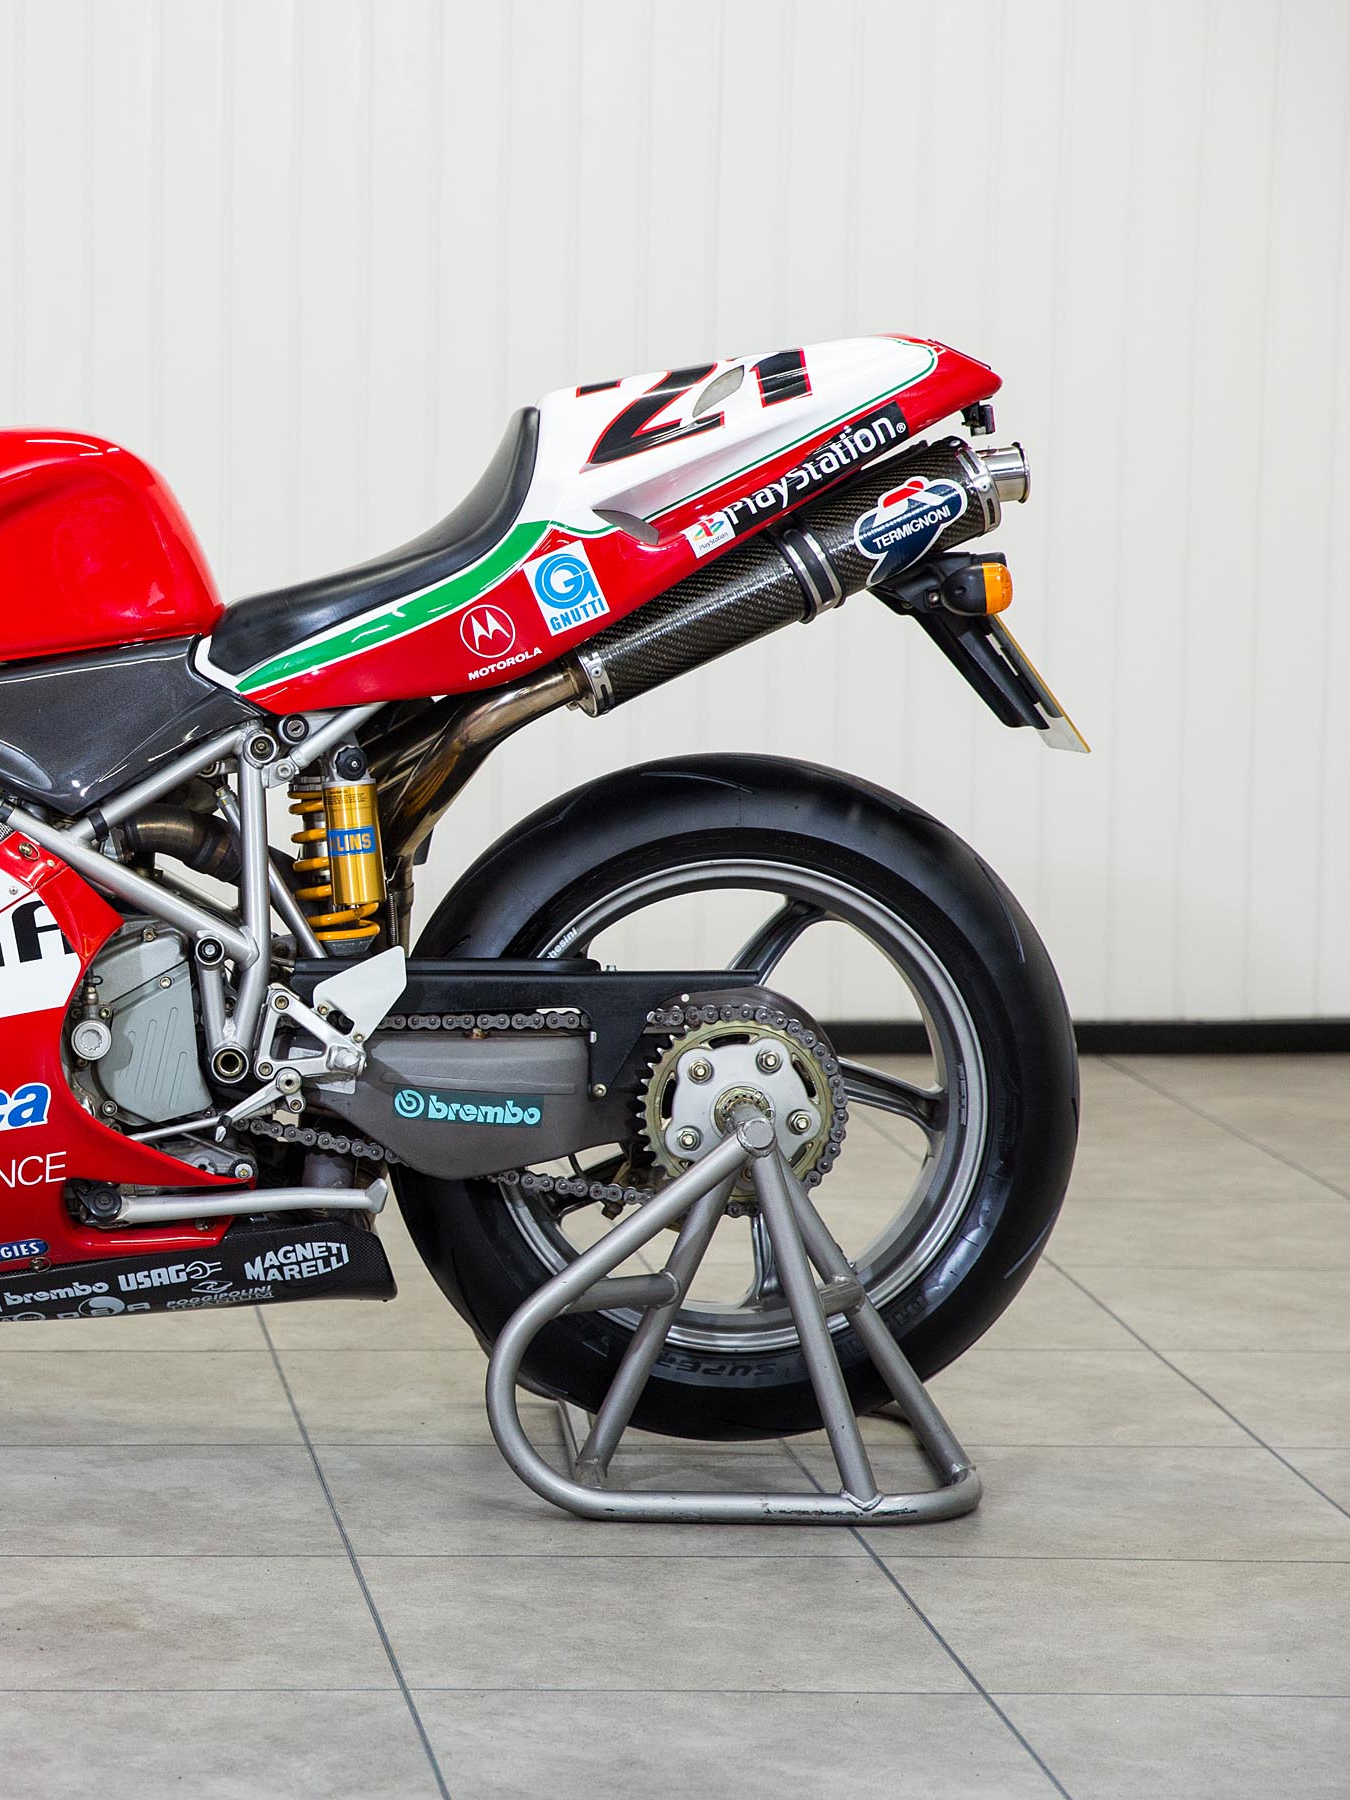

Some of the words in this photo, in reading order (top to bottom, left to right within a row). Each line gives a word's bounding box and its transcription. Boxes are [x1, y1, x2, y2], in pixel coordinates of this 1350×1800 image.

[873, 505, 952, 549] TERMIGNONI
[550, 598, 605, 631] GNUTTI
[468, 647, 542, 681] MOTOROLA
[332, 833, 372, 852] LINS
[428, 1095, 541, 1125] brembo
[244, 1242, 349, 1271] MAGNETI
[244, 1253, 349, 1282] MARELLI
[117, 1264, 188, 1292] USAG
[5, 1281, 109, 1306] brembo
[166, 1285, 272, 1307] POGGIPOLINI
